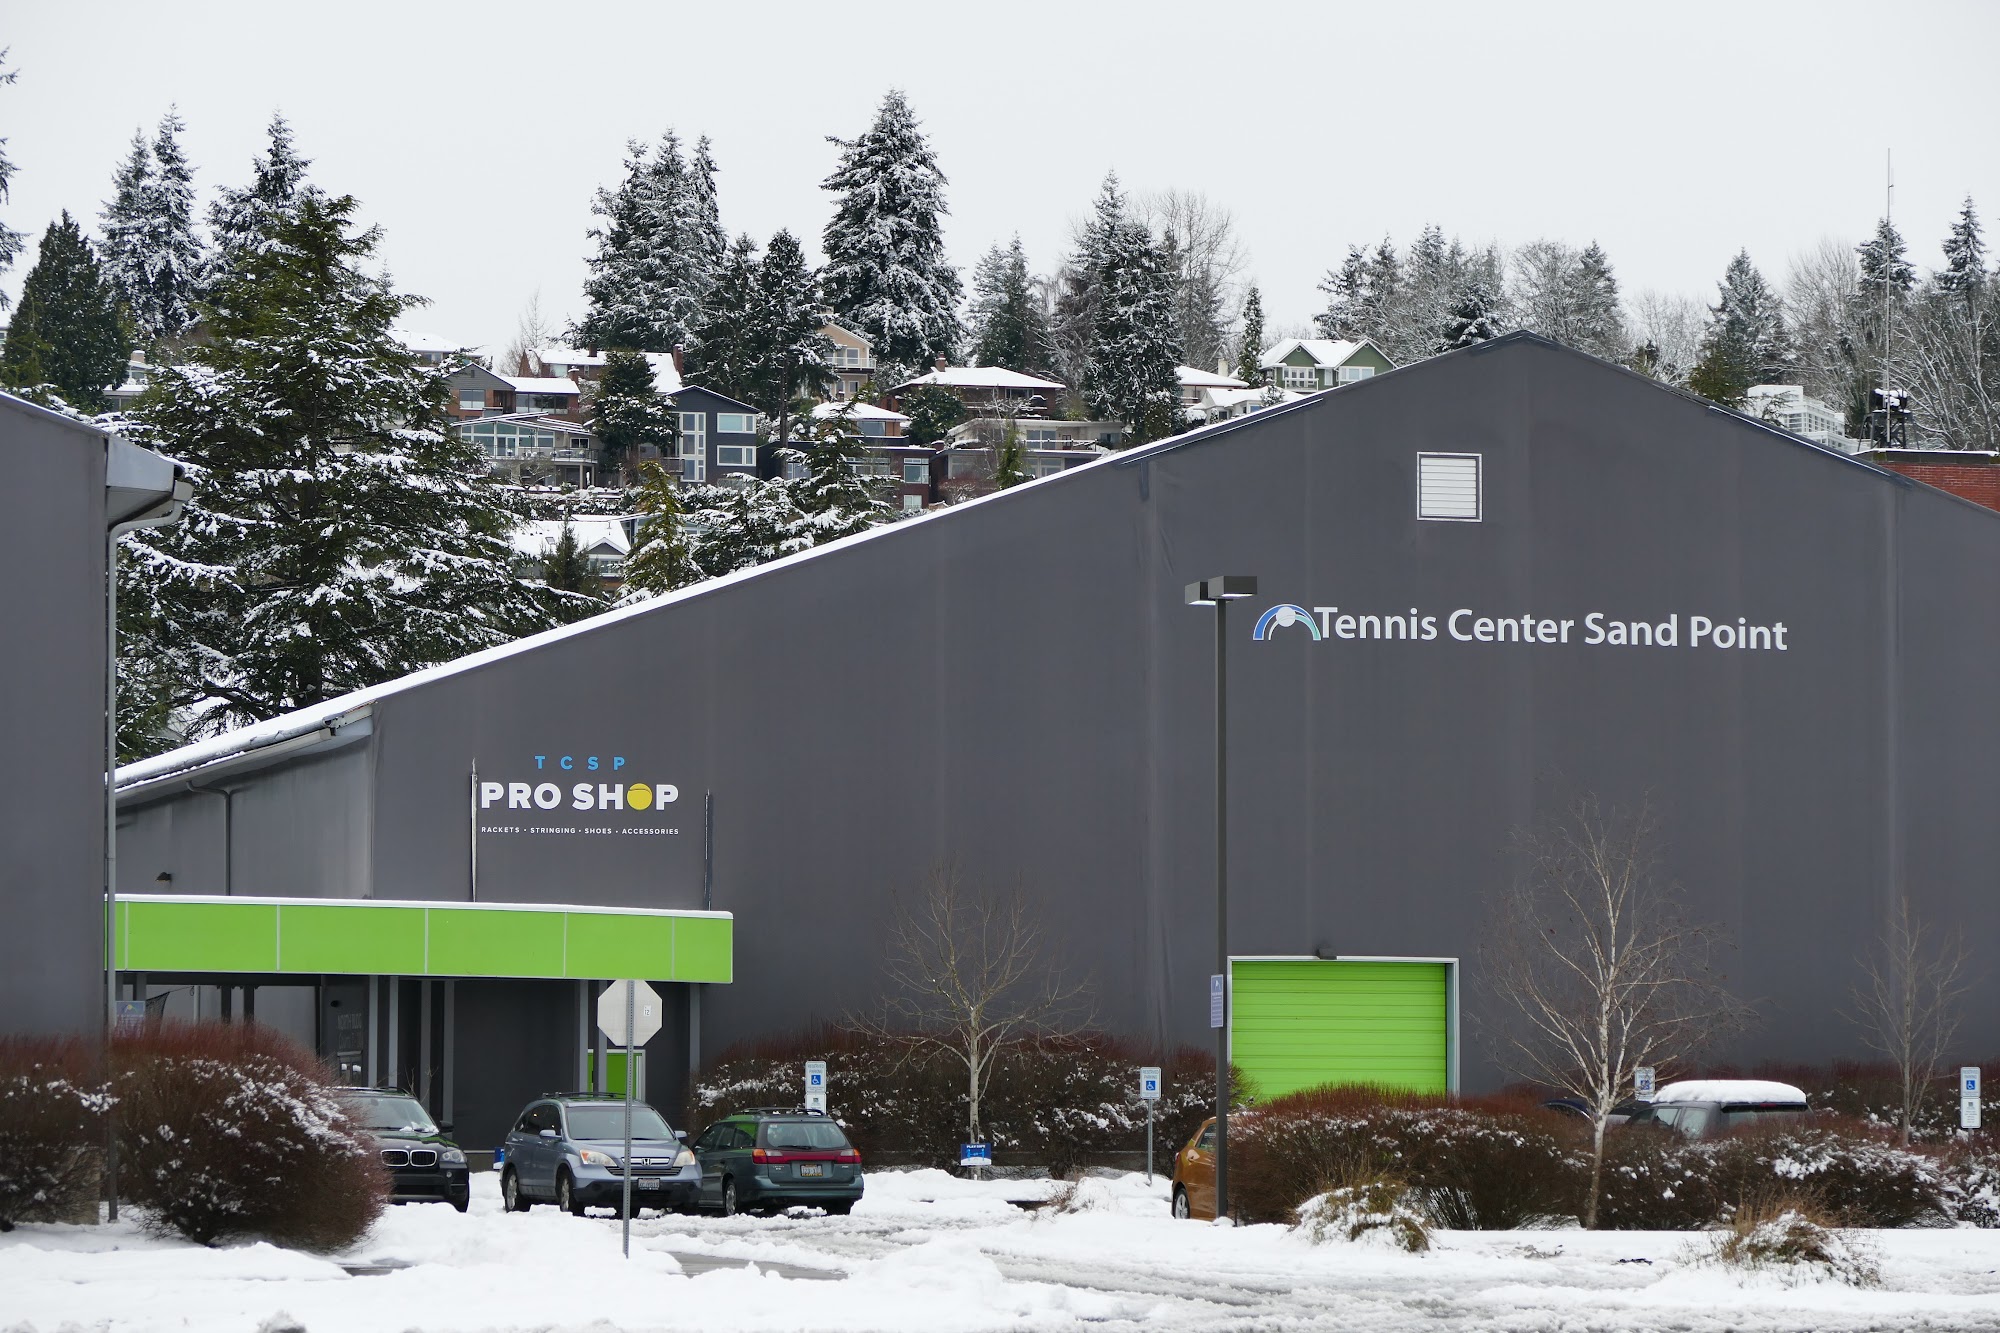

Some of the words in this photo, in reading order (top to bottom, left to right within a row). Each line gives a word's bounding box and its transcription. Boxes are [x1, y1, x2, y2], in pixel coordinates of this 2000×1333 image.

[1314, 606, 1438, 641] Tennis
[1448, 608, 1576, 643] Center
[1584, 612, 1679, 647] Sand
[1690, 615, 1788, 651] Point
[481, 781, 562, 810] PRO
[571, 782, 679, 811] SHOP
[481, 826, 520, 834] RACKETS
[530, 827, 576, 835] STRINGING
[584, 827, 612, 835] SHOES
